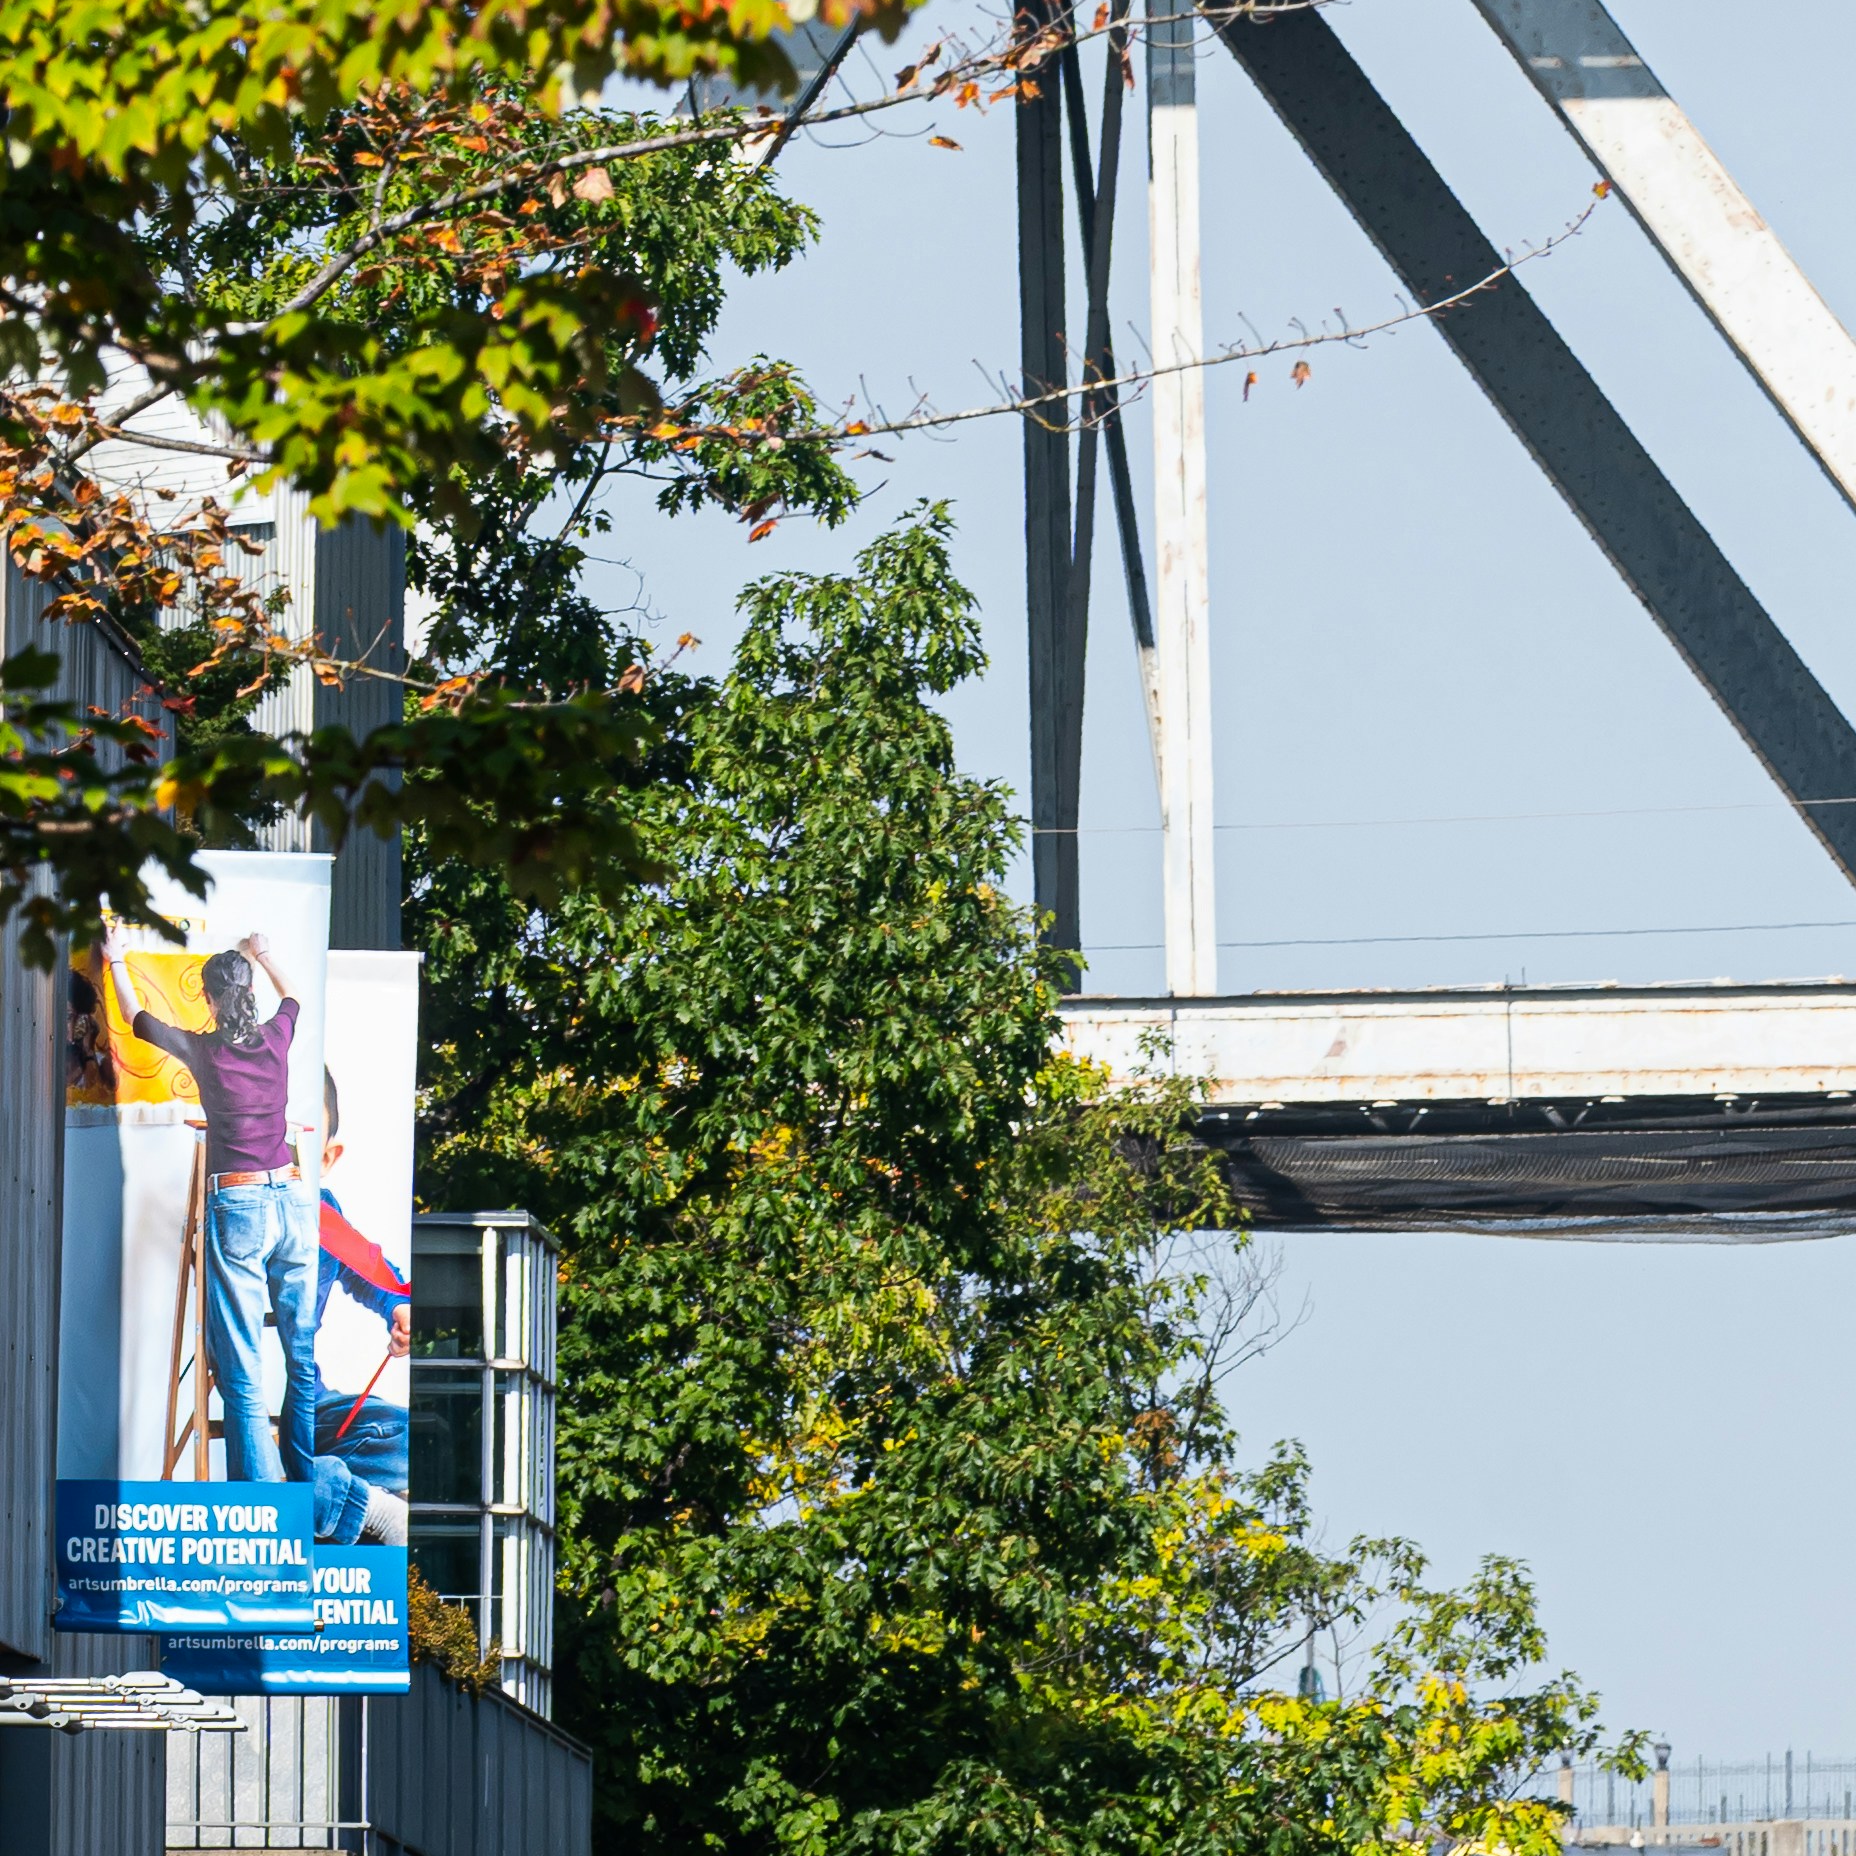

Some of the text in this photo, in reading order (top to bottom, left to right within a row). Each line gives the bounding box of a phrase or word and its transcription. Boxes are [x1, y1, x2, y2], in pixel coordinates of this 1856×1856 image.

[95, 1504, 278, 1532] DISCOVER YOUR
[67, 1537, 308, 1565] CREATIVE POTENTIAL
[69, 1575, 308, 1595] artsumbrella.com/programs
[313, 1567, 371, 1594] YOUR
[313, 1599, 399, 1625] TENTIAL
[168, 1635, 400, 1654] artsumbrella.com/programs
